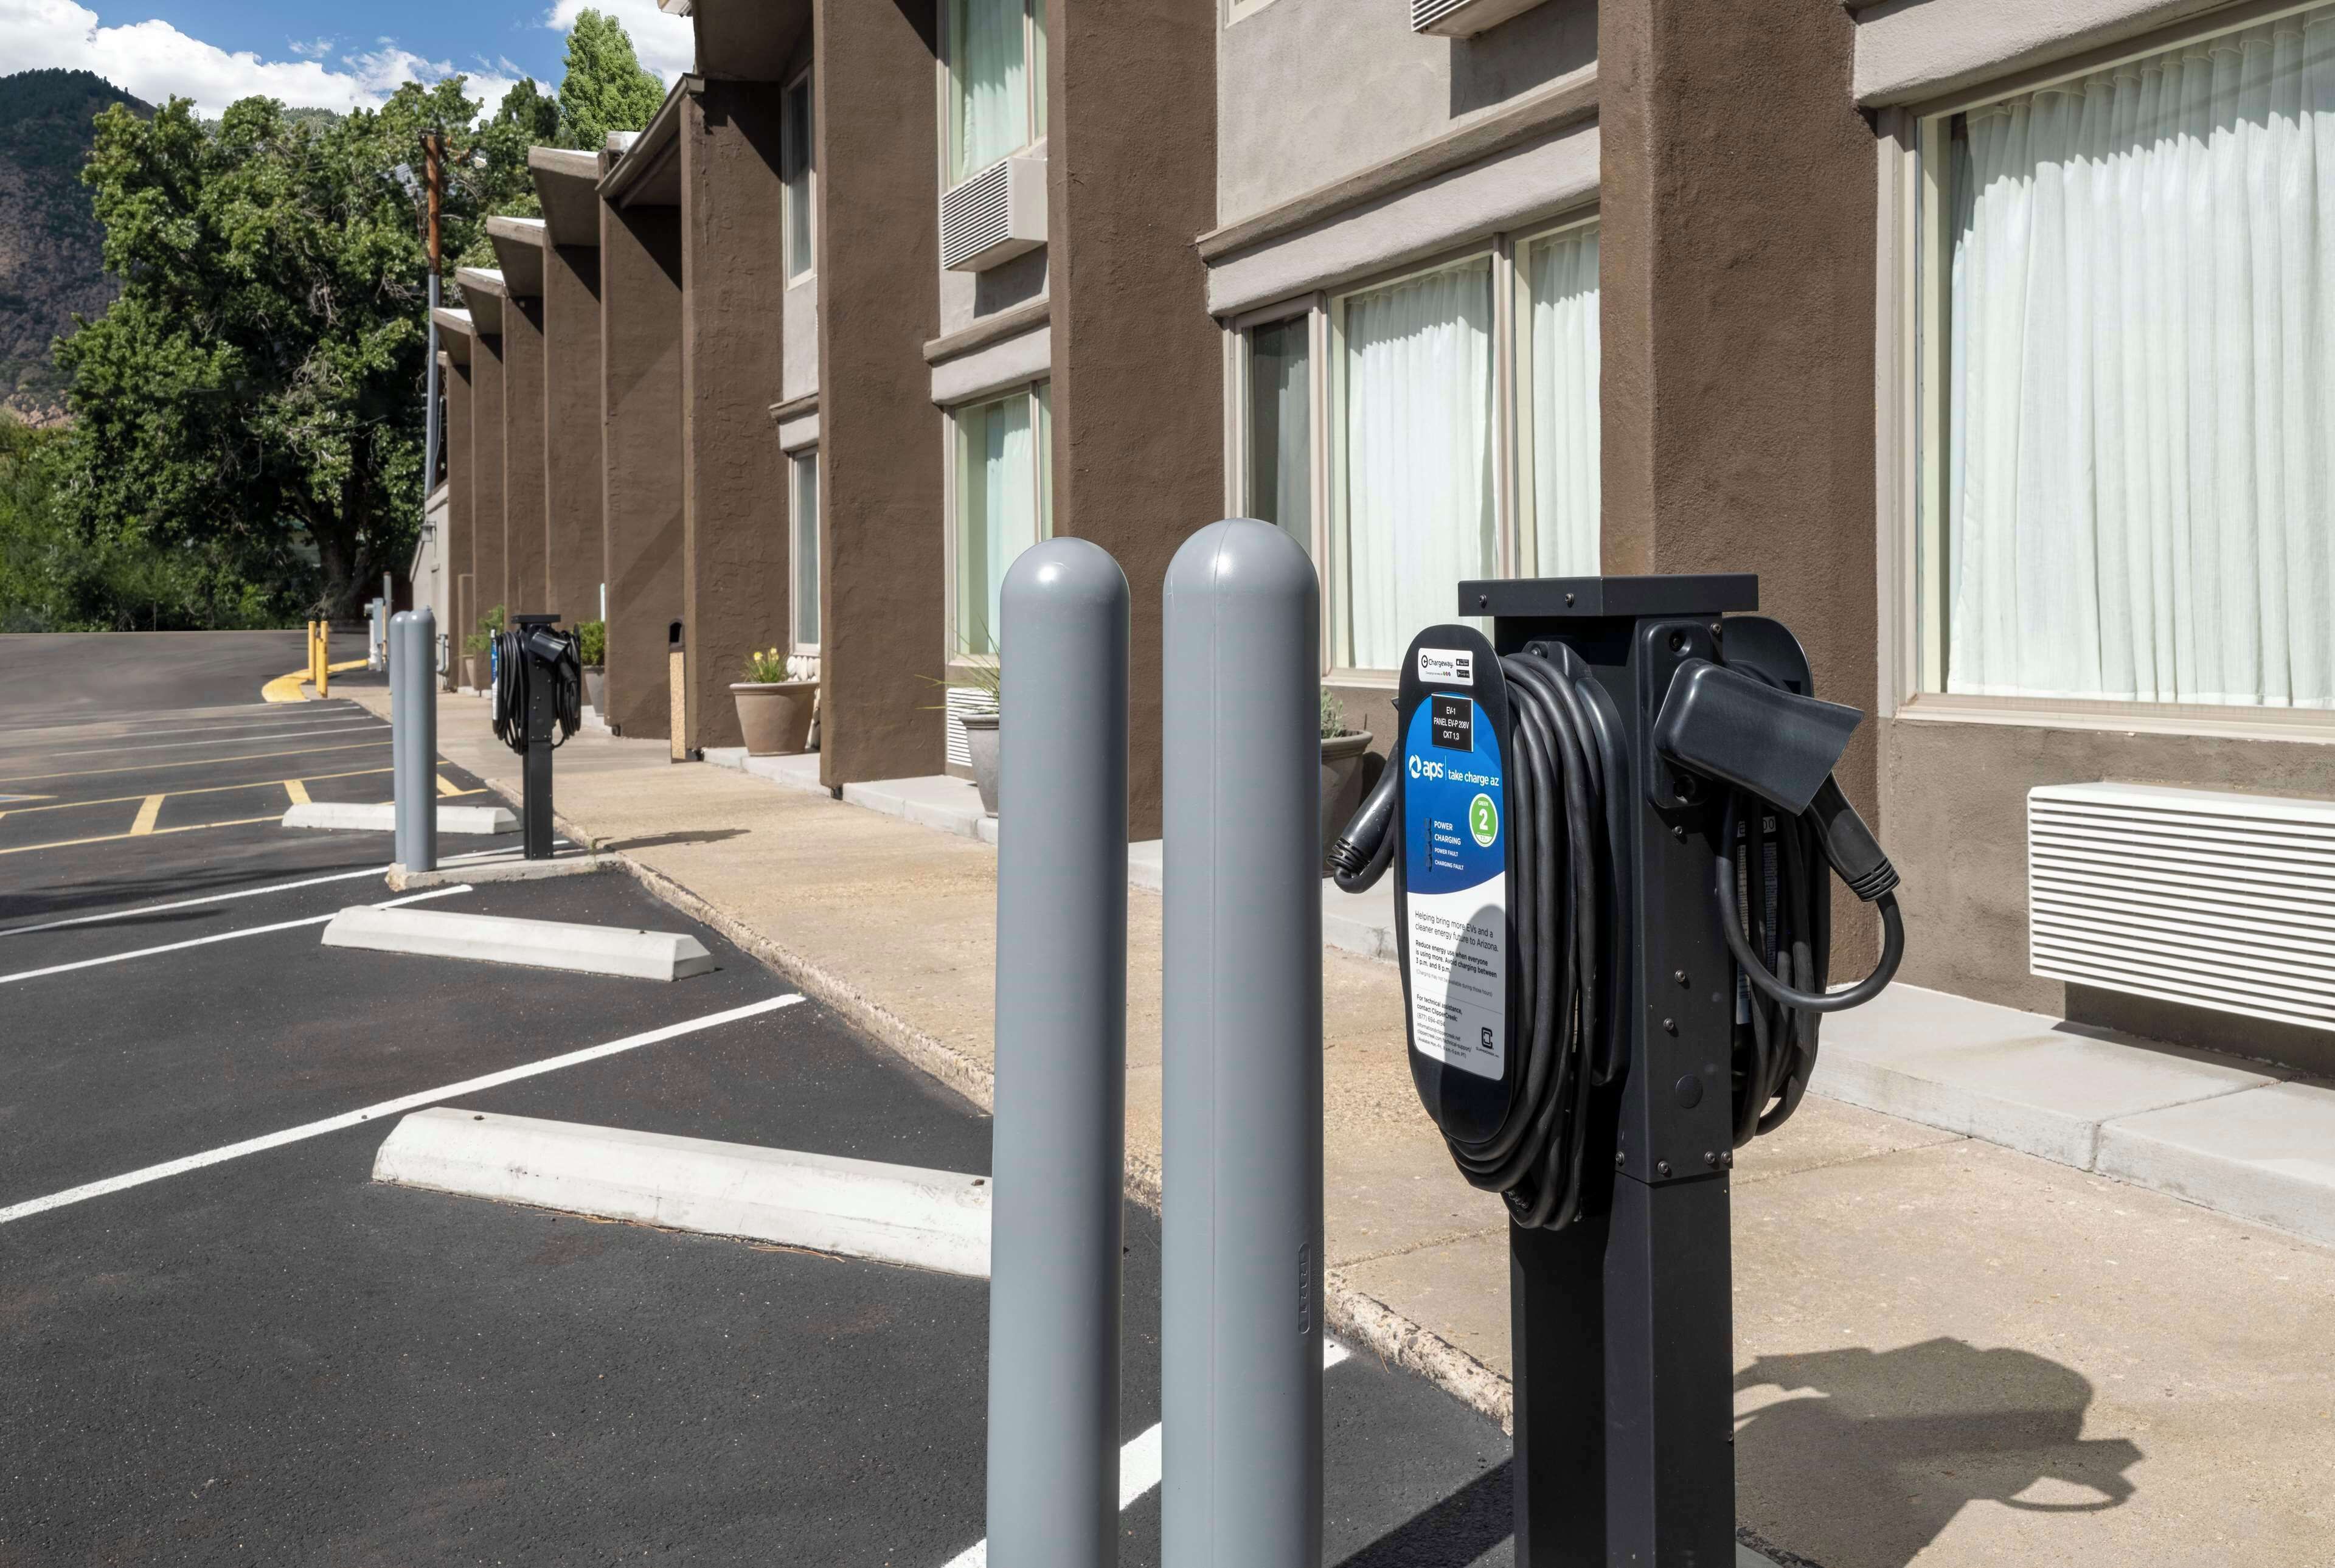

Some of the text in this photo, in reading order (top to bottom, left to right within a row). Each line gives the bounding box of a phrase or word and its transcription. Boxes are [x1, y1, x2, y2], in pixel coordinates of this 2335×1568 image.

[1429, 659, 1453, 668] Chargeway
[1446, 706, 1455, 715] EV-1
[1434, 717, 1469, 729] PANEL EV-P 208V
[1443, 730, 1452, 740] CKT
[1423, 760, 1443, 781] aps
[1448, 769, 1499, 786] take charge az
[1434, 820, 1452, 831] POWER
[1479, 808, 1488, 830] 2
[1434, 834, 1461, 845] CHARGING
[1435, 860, 1452, 869] CHARGING
[1415, 911, 1435, 924] Helping
[1436, 914, 1450, 928] bring
[1451, 921, 1465, 930] more
[1466, 923, 1477, 934] EVs
[1478, 928, 1488, 937] and
[1415, 923, 1433, 934] cleaner
[1434, 929, 1452, 940] energy
[1453, 933, 1468, 943] future
[1477, 939, 1498, 952] Arizona.
[1416, 940, 1431, 951] Reduce
[1432, 945, 1446, 956] energy
[1455, 951, 1467, 960] when
[1468, 955, 1488, 966] everyone
[1420, 952, 1431, 962] using
[1445, 956, 1457, 967] Avoid
[1458, 961, 1477, 973] charging
[1477, 966, 1497, 978] between
[1417, 1004, 1458, 1022] contact ClipperCreek:
[1424, 997, 1441, 1007] technical
[1442, 1002, 1463, 1015] assistance,
[1417, 1013, 1445, 1027] (877) 694-4194
